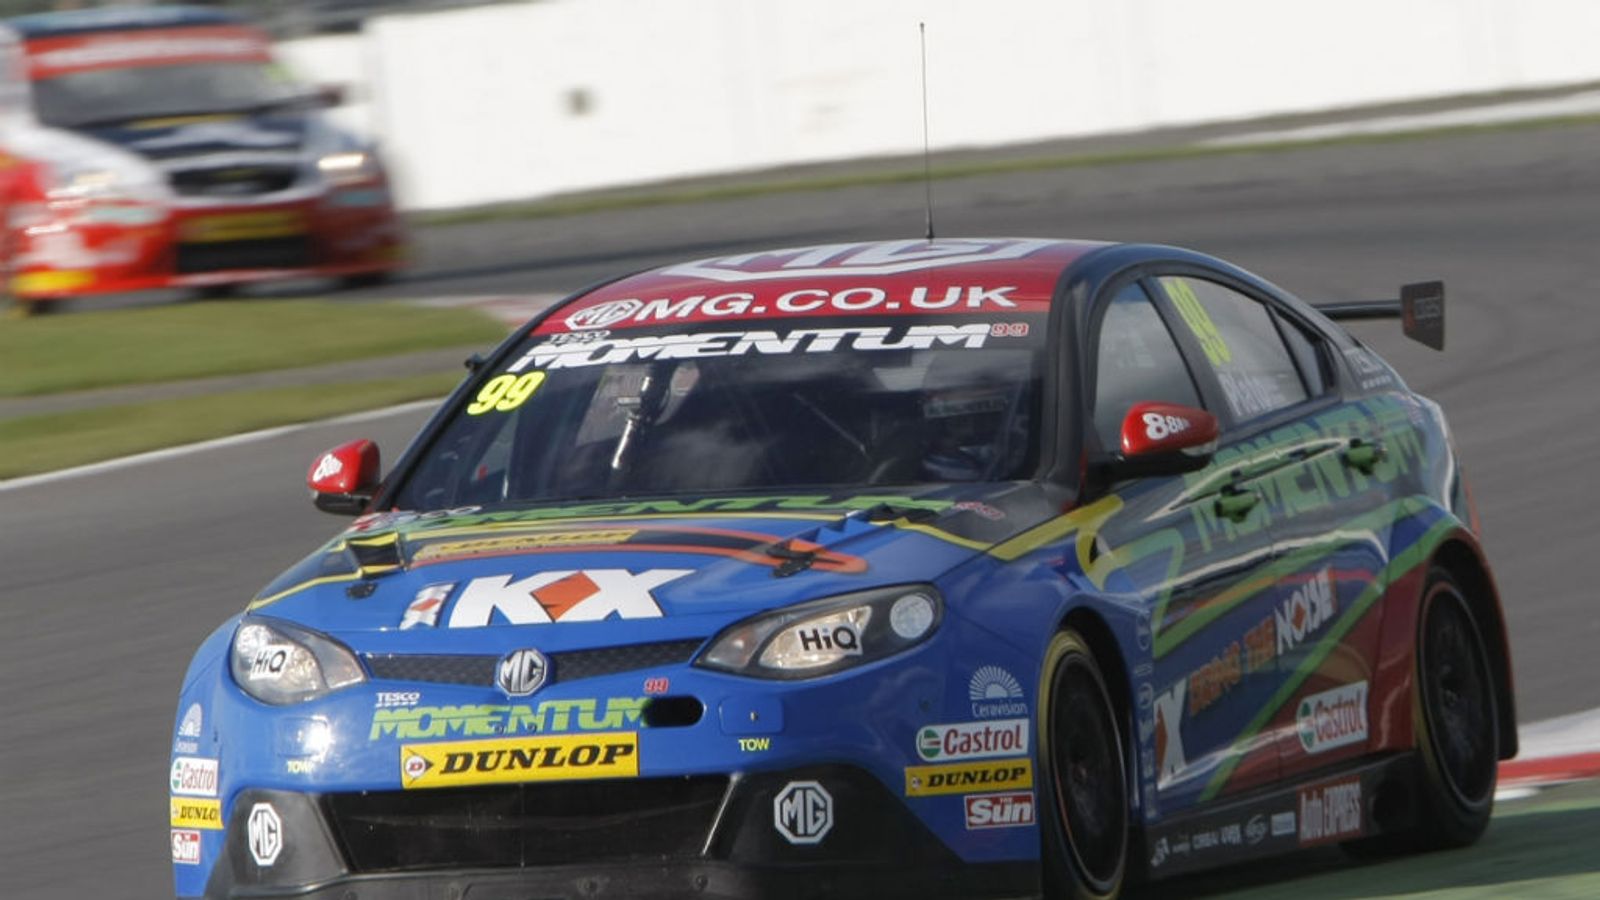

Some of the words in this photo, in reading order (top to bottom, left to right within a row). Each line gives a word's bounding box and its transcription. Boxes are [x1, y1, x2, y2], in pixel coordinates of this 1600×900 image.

[635, 286, 1018, 322] MG.CO.UK
[991, 323, 1029, 337] 99
[507, 323, 990, 372] MOMENTUM
[467, 371, 545, 416] 99
[449, 569, 697, 628] KX
[799, 626, 858, 651] HiQ
[253, 651, 286, 673] HiQ
[499, 650, 546, 695] MG
[376, 692, 421, 703] TESCO
[643, 678, 669, 694] 99
[369, 697, 650, 740] MOMENTUM
[972, 702, 1028, 717] Ceravision
[739, 738, 770, 751] TOW
[944, 725, 1022, 755] Castrol
[287, 761, 313, 773] TOW
[439, 743, 634, 775] DUNLOP
[181, 763, 217, 791] Castrol
[927, 767, 1026, 787] DUNLOP
[180, 806, 219, 821] DUNLO
[781, 788, 829, 836] MG
[969, 799, 1032, 824] Sun
[251, 809, 279, 859] MG
